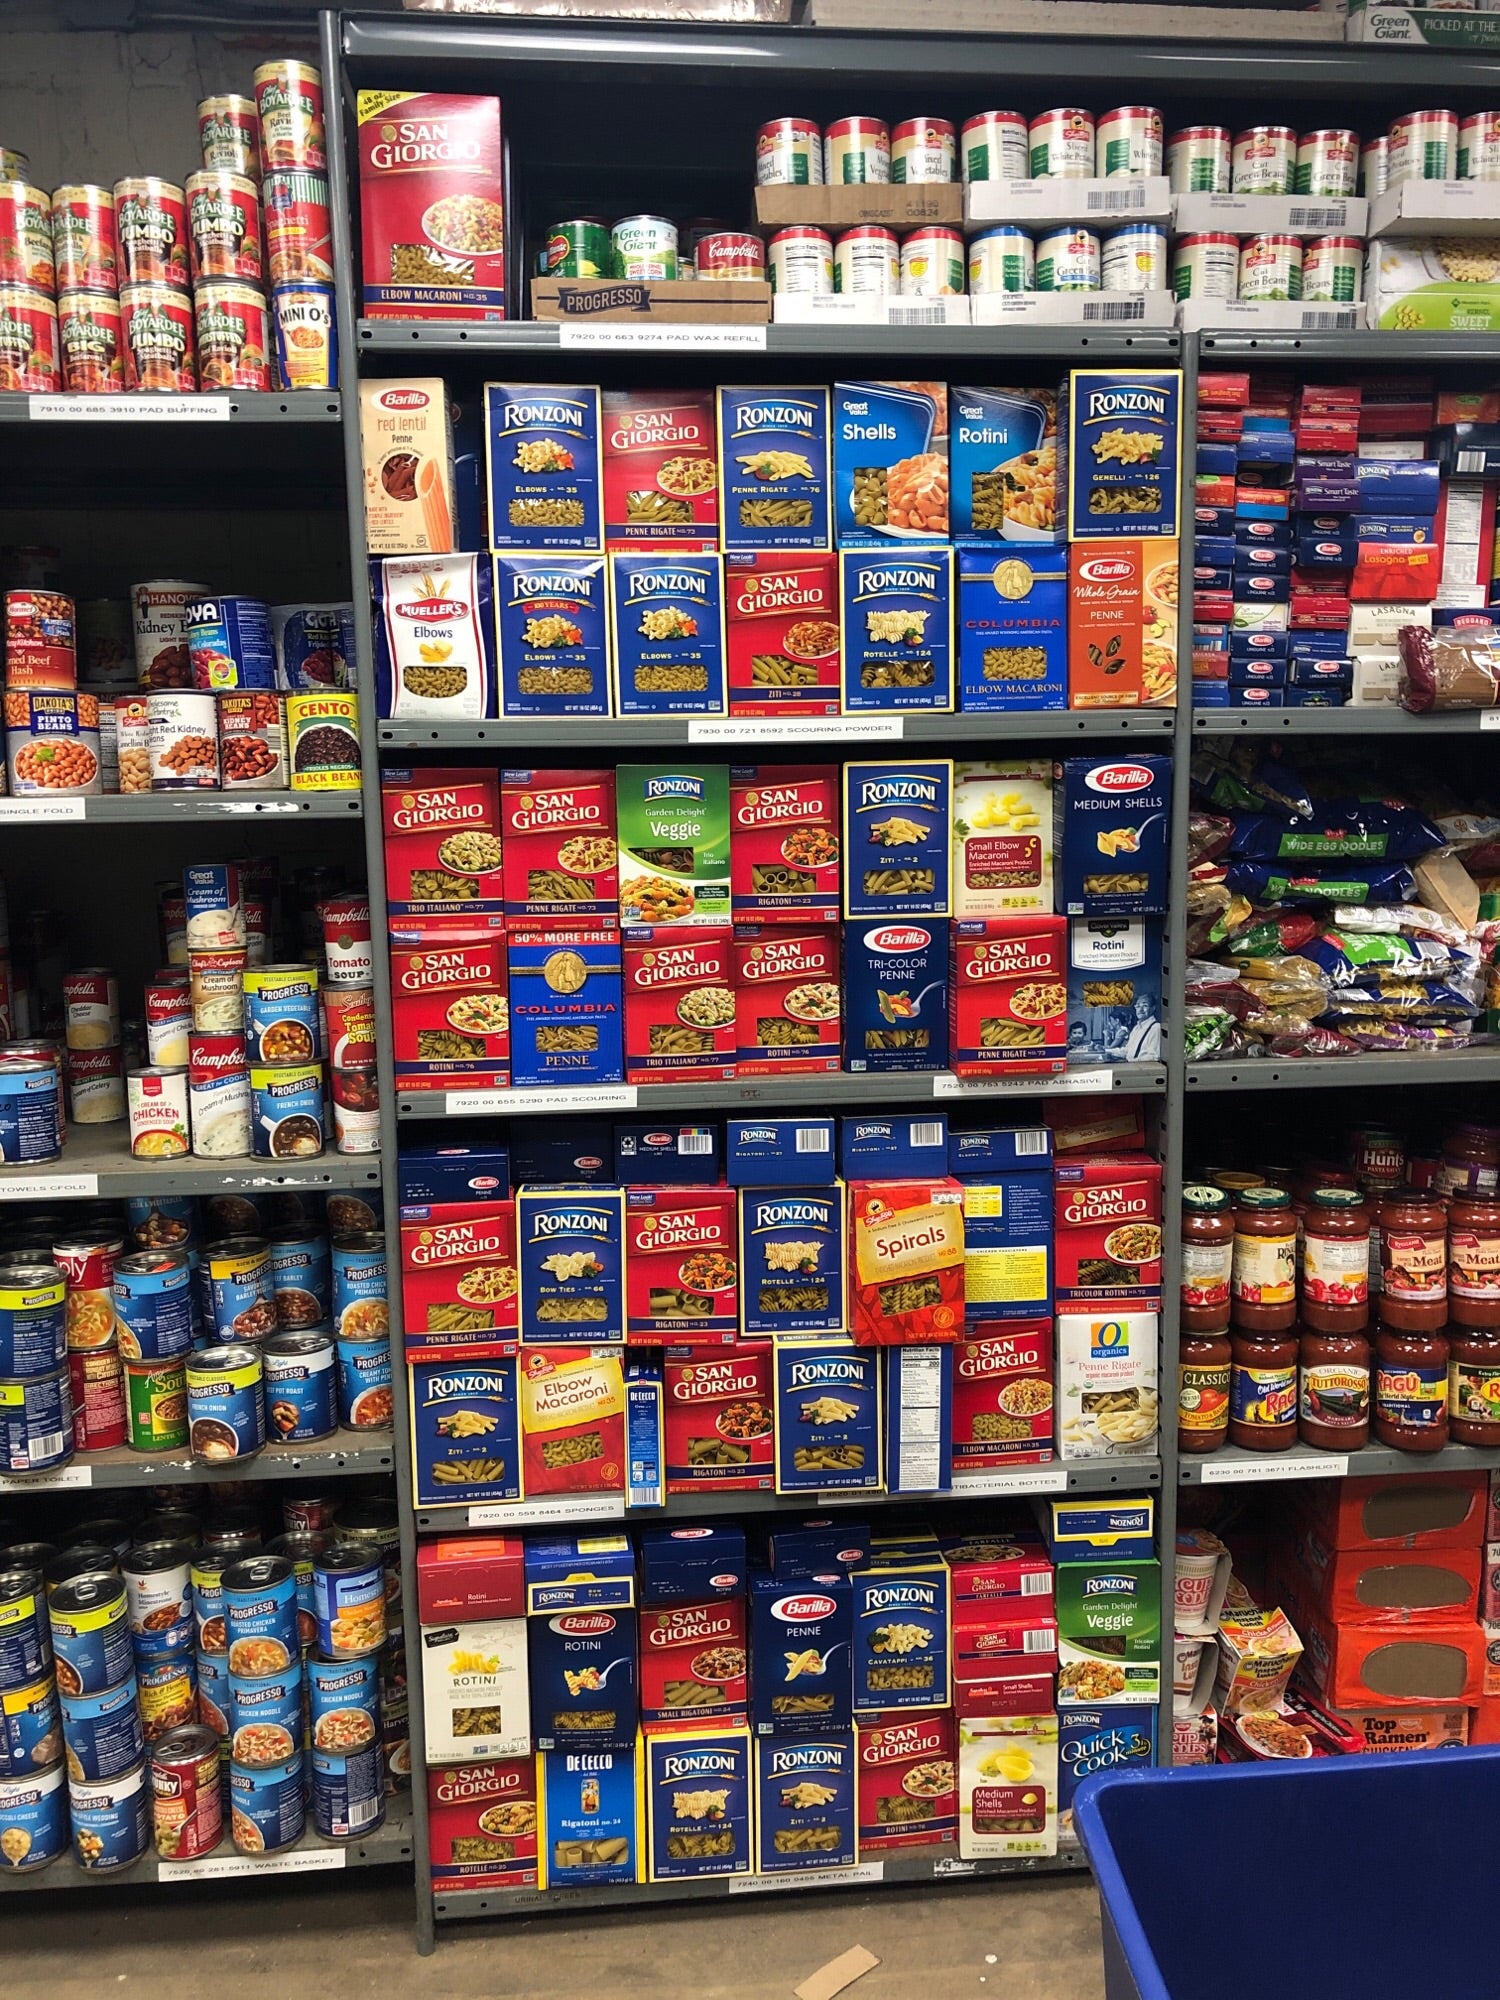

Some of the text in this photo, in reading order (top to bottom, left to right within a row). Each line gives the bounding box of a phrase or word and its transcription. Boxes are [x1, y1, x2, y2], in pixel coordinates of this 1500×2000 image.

[1370, 14, 1410, 29] Green
[1424, 19, 1461, 31] PICKED
[1479, 20, 1497, 32] THE
[1374, 26, 1411, 40] Giant
[399, 123, 448, 142] SAN
[370, 140, 481, 169] GIORGIO
[380, 289, 462, 301] ELBOW MACARONI
[567, 289, 641, 313] PROGRESSO
[280, 309, 306, 325] MINI
[132, 334, 185, 351] JUMBO
[384, 392, 426, 407] Barilla
[1090, 393, 1165, 416] RONZONI
[377, 415, 427, 431] red lentil
[505, 404, 583, 429] RONZONI
[634, 412, 673, 430] SAN
[736, 406, 813, 430] RONZONI
[391, 433, 413, 444] Penne
[610, 425, 699, 450] GIORGIO
[843, 423, 897, 441] Shells
[959, 427, 1008, 444] Rotini
[1364, 554, 1405, 564] Lasagna
[1091, 563, 1130, 576] Barilla
[513, 573, 591, 598] RONZONI
[1073, 584, 1140, 599] Whole Grain
[1090, 609, 1124, 620] PENNE
[1371, 606, 1416, 617] LASAGNA
[966, 618, 1061, 629] COLUMBIA
[414, 625, 453, 639] Elbows
[965, 683, 1062, 695] ELBOW MACARONI
[299, 703, 350, 716] CENTO
[38, 716, 72, 725] PINTO
[38, 722, 73, 731] BEANS
[295, 773, 326, 784] BLACK
[1100, 770, 1148, 787] Barilla
[647, 780, 701, 796] RONZONI
[1074, 797, 1163, 810] MEDIUM SHELLS
[645, 807, 704, 818] Garden Delight
[650, 822, 701, 841] Veggie
[969, 840, 1020, 850] Small Elbow
[1286, 840, 1384, 851] WIDE EGG NOODLES
[969, 850, 1009, 860] Macaroni
[514, 931, 614, 944] 50% MORE FREE
[879, 932, 926, 946] Barilla
[1092, 939, 1125, 951] Rotini
[328, 957, 370, 968] Tomato
[425, 953, 465, 969] SAN
[868, 958, 927, 970] TRI-COLOR
[334, 970, 364, 980] SOUP
[401, 965, 491, 990] GIORGIO
[879, 969, 916, 981] PENNE
[262, 983, 308, 1001] PROGRESSO
[514, 1004, 616, 1014] COLUMBIA
[545, 1055, 589, 1066] PENNE
[133, 1107, 179, 1121] CHICKEN
[534, 1214, 607, 1236] RONZONI
[876, 1227, 945, 1261] Spirals
[1413, 1253, 1443, 1267] Meat
[1091, 1347, 1127, 1357] organics
[1079, 1360, 1142, 1371] Penne Rigate
[544, 1375, 593, 1397] Elbow
[535, 1383, 609, 1411] Macaroni
[42, 1475, 80, 1483] TOILET
[1019, 1479, 1058, 1487] BOTTES
[565, 1505, 615, 1514] SPONGES
[230, 1600, 274, 1620] PROGRESSO
[785, 1600, 832, 1614] Barilla
[565, 1617, 610, 1630] Barilla
[1087, 1613, 1133, 1631] Veggie
[786, 1626, 822, 1637] PENNE
[565, 1641, 601, 1651] ROTINI
[319, 1671, 364, 1691] PROGRESSO
[453, 1676, 497, 1687] ROTINI
[1363, 1716, 1397, 1731] Top
[1364, 1731, 1427, 1744] Ramen
[1061, 1729, 1125, 1763] Quick
[1073, 1752, 1130, 1777] Cook
[975, 1788, 1014, 1801] Medium
[976, 1798, 1003, 1808] Shells
